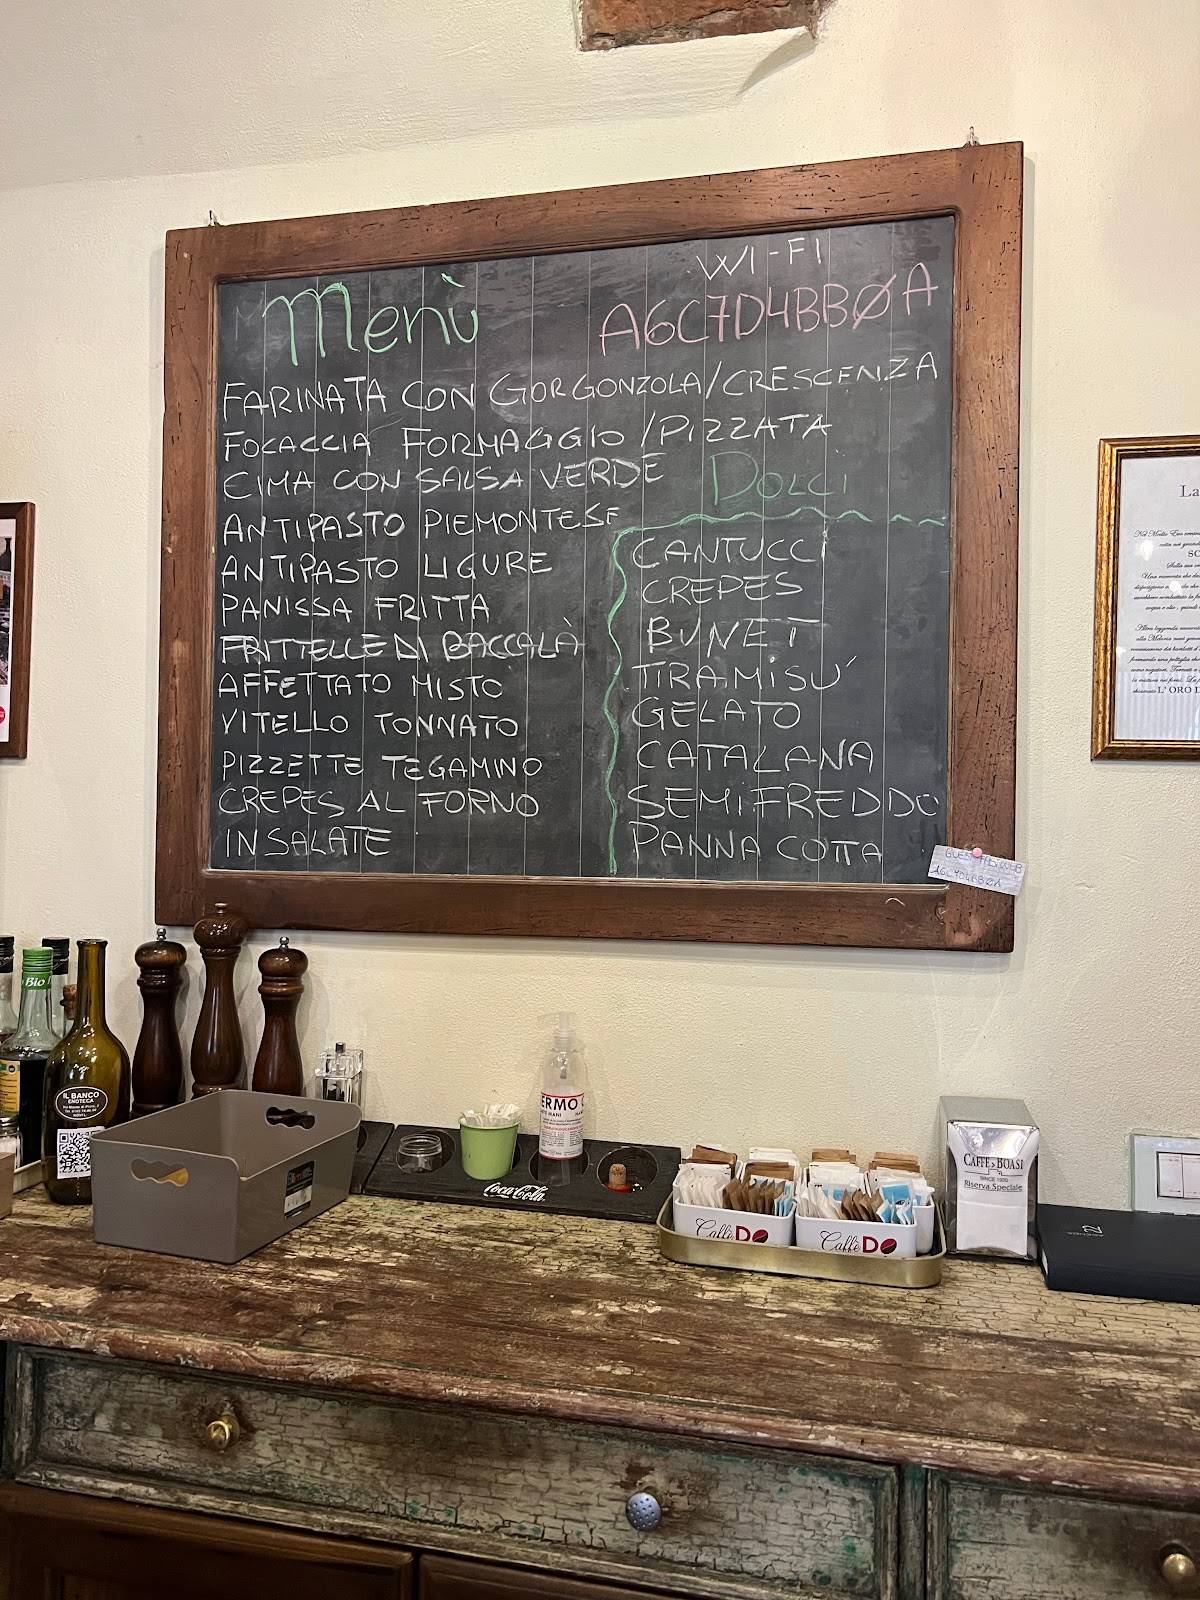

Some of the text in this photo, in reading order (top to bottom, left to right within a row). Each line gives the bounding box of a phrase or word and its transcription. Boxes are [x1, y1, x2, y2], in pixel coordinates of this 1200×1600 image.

[223, 376, 387, 421] FARINATA
[401, 380, 475, 411] CON
[223, 431, 372, 461] FOCACCIA
[401, 424, 624, 460] FORMAGGIO
[223, 452, 665, 500] CIMA CON SALSA VERDE
[223, 510, 405, 546] ANTIPASTO
[632, 535, 828, 569] CANTUCCI
[221, 551, 552, 589] ANTIPASTO LIGURE
[642, 572, 804, 606] CREPES
[222, 593, 490, 627] PANISSA FRITTA
[220, 633, 387, 664] FRITTELLE
[394, 634, 428, 662] DI
[647, 616, 820, 657] BUNET
[218, 669, 503, 701] AFFETTATO MISTO
[1169, 686, 1192, 694] ORO
[221, 708, 519, 739] VITELLO TONNATO
[632, 696, 801, 729] GELATO
[222, 751, 543, 781] PIZZETTE TEGAMINO
[636, 739, 874, 773] CATALANA
[218, 786, 540, 818] CREPES AL FORNO
[225, 825, 392, 858] INSALATE
[628, 821, 883, 866] PANNA COTTA
[25, 977, 45, 987] Bio
[71, 1091, 99, 1099] BANCO
[964, 1179, 1023, 1192] Riserva Speciale
